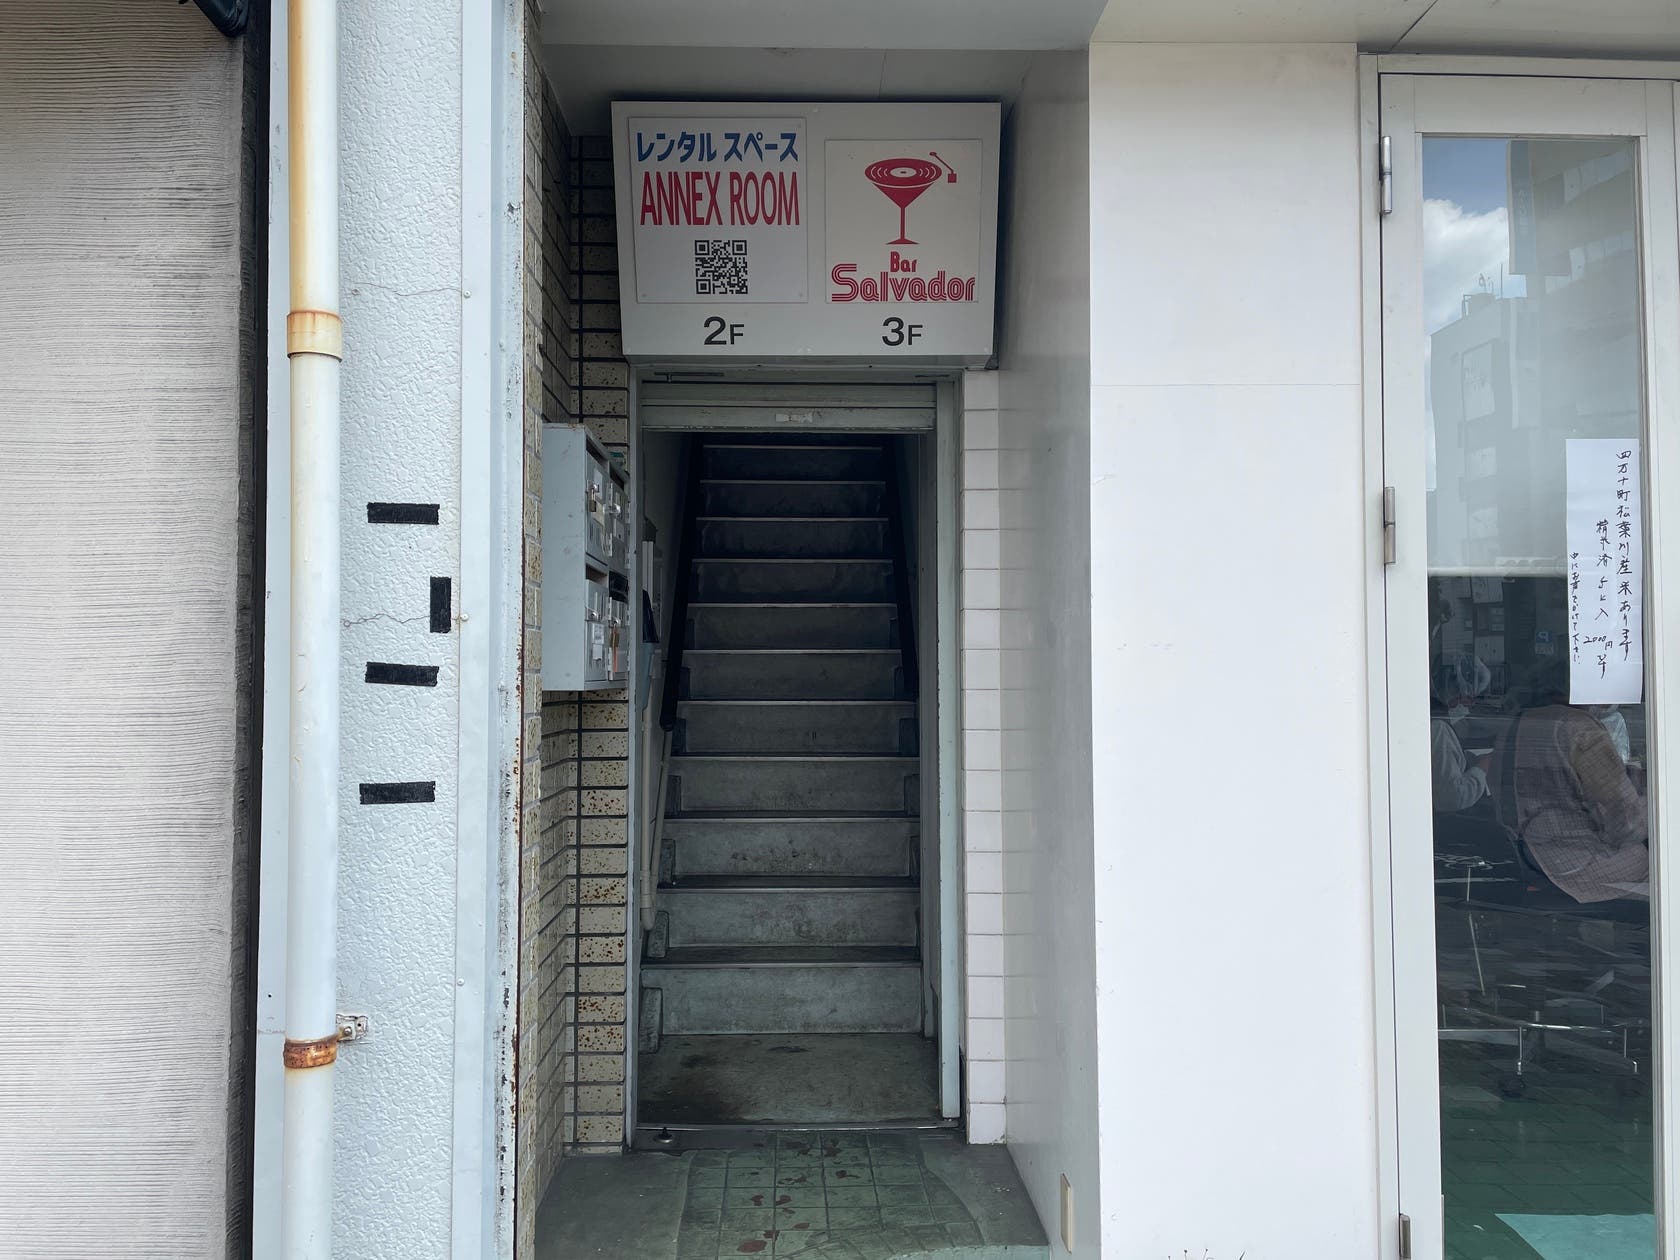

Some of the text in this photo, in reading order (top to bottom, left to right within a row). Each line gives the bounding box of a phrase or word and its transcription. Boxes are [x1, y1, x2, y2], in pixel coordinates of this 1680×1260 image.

[636, 131, 799, 163] レンタル スペース
[640, 171, 800, 226] ANNEX ROOM
[890, 250, 918, 273] Bar
[831, 263, 976, 302] Salvador
[703, 316, 745, 346] 2F
[881, 316, 924, 347] 3F
